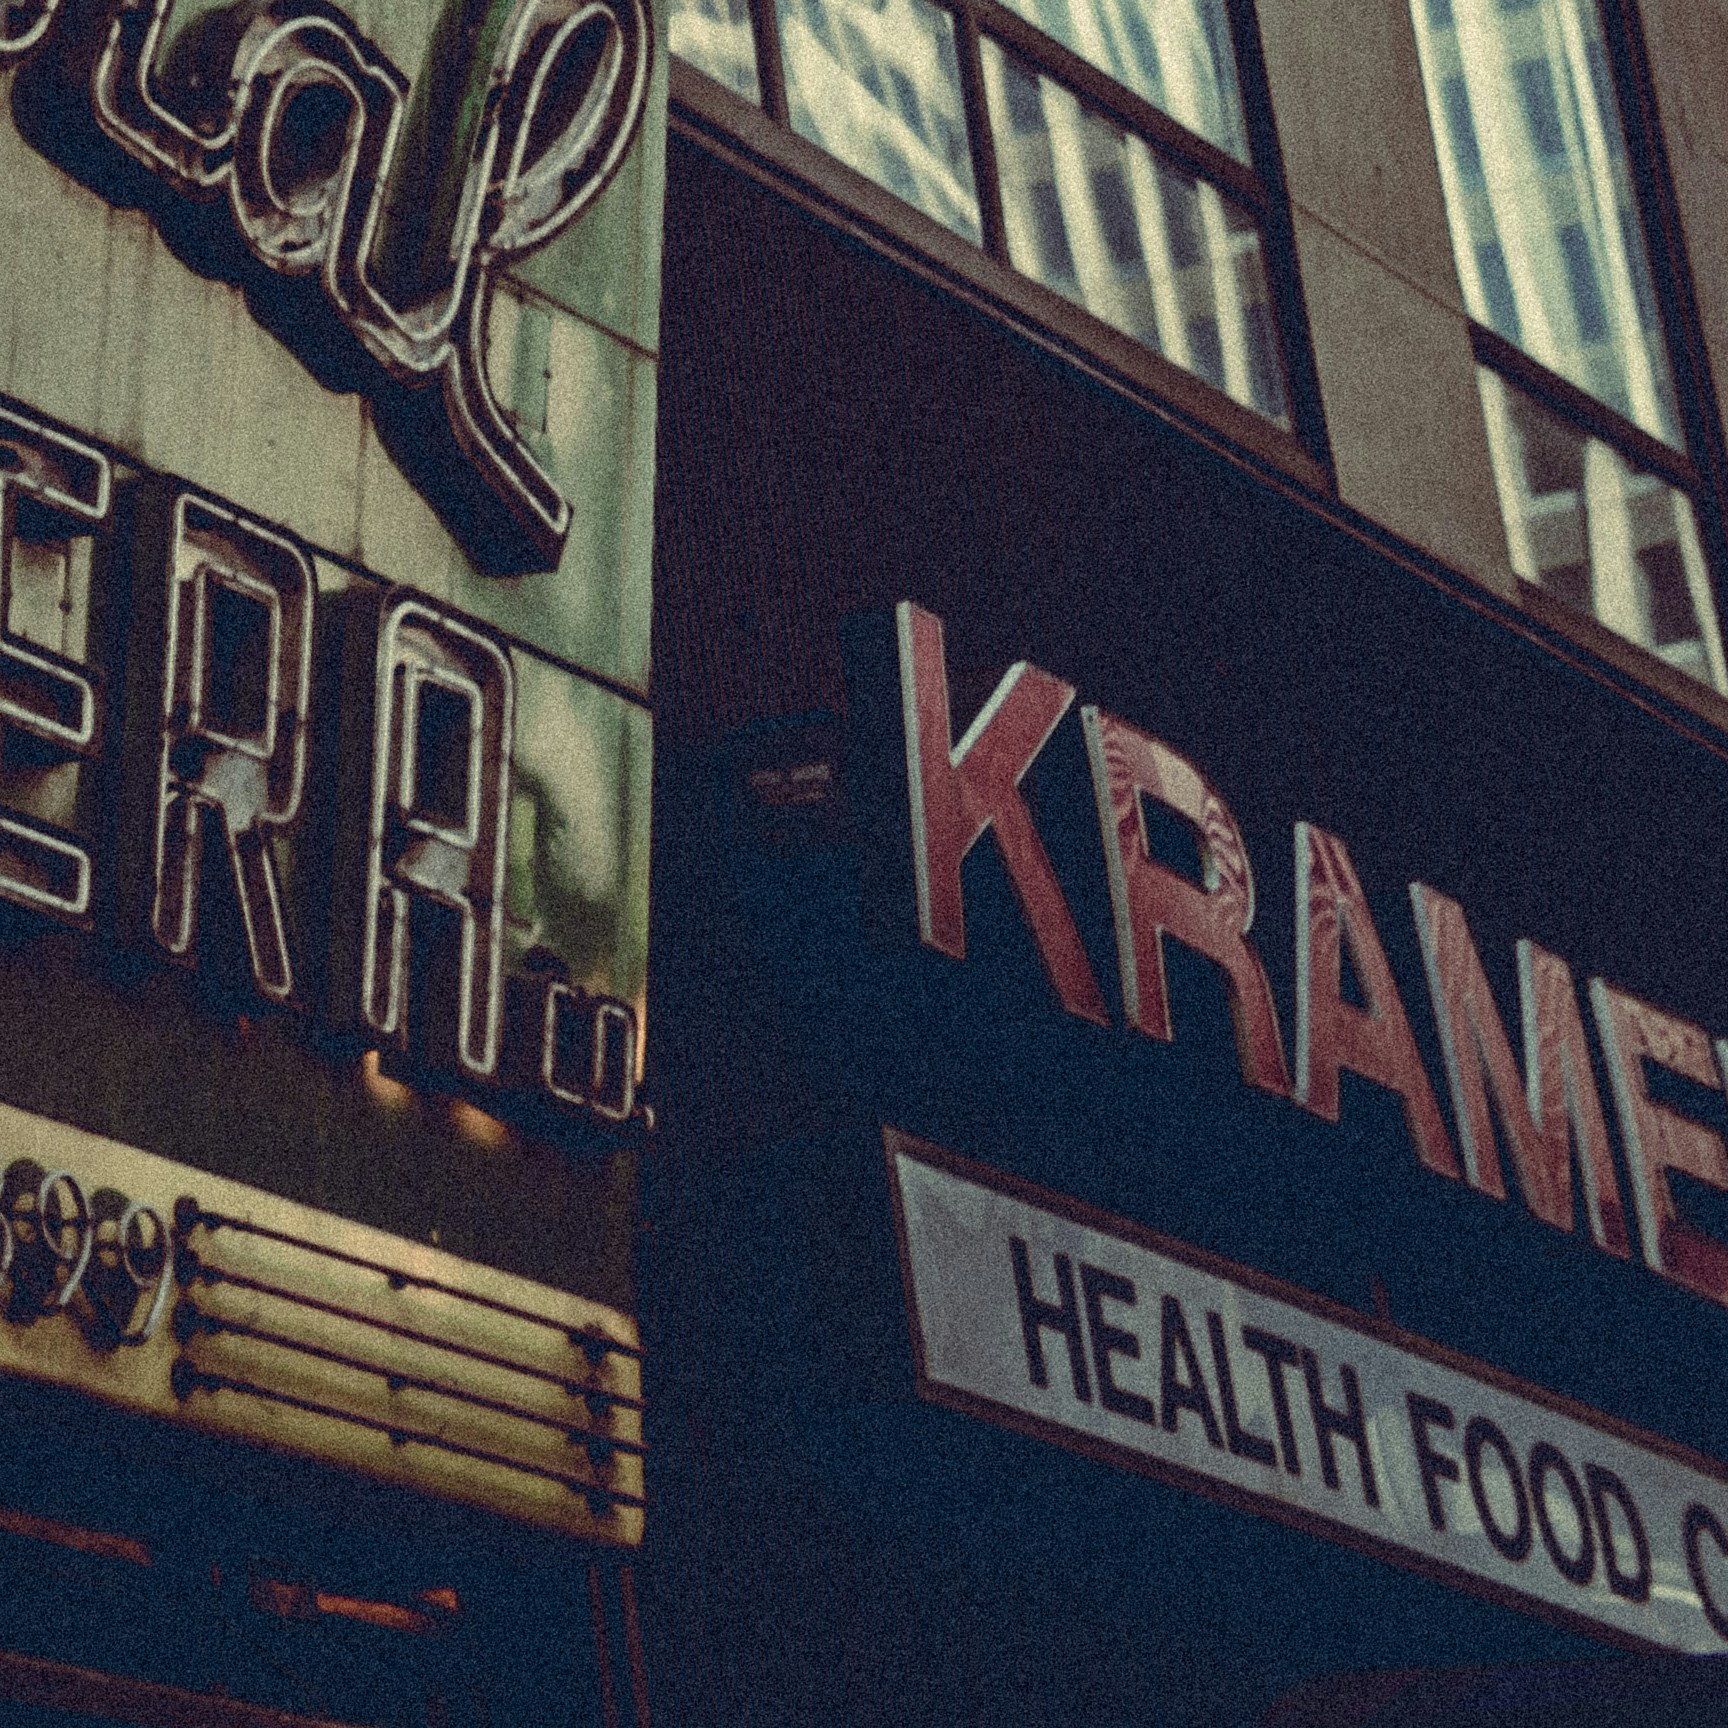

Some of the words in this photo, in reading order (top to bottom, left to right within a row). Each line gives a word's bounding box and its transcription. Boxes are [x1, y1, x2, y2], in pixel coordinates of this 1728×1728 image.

[896, 600, 1728, 1308] KRAME
[1009, 1235, 1381, 1508] HEALTH
[1407, 1391, 1653, 1602] FOOD
